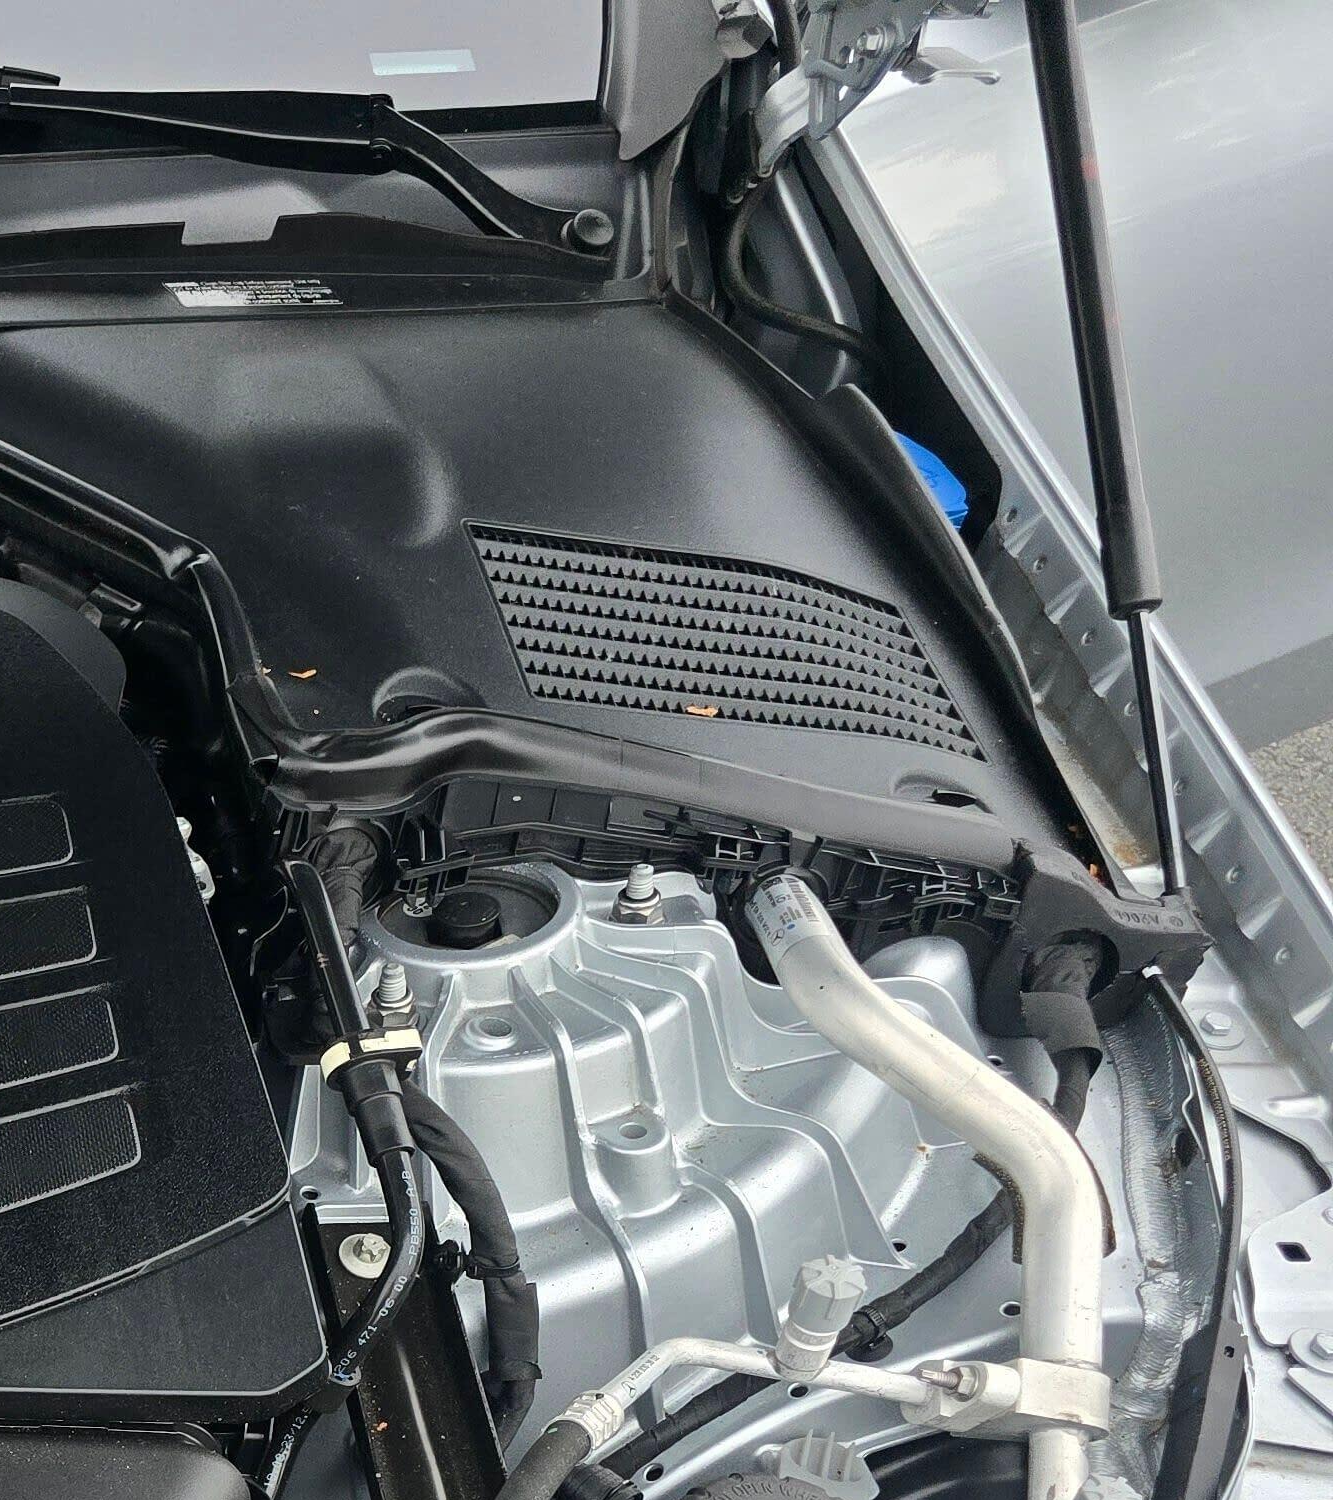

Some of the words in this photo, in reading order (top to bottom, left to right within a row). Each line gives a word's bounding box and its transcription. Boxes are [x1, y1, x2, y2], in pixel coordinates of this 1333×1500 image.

[357, 1325, 378, 1346] 471
[379, 1297, 395, 1317] 06
[393, 1275, 408, 1293] 00
[732, 1482, 774, 1497] OPEN
